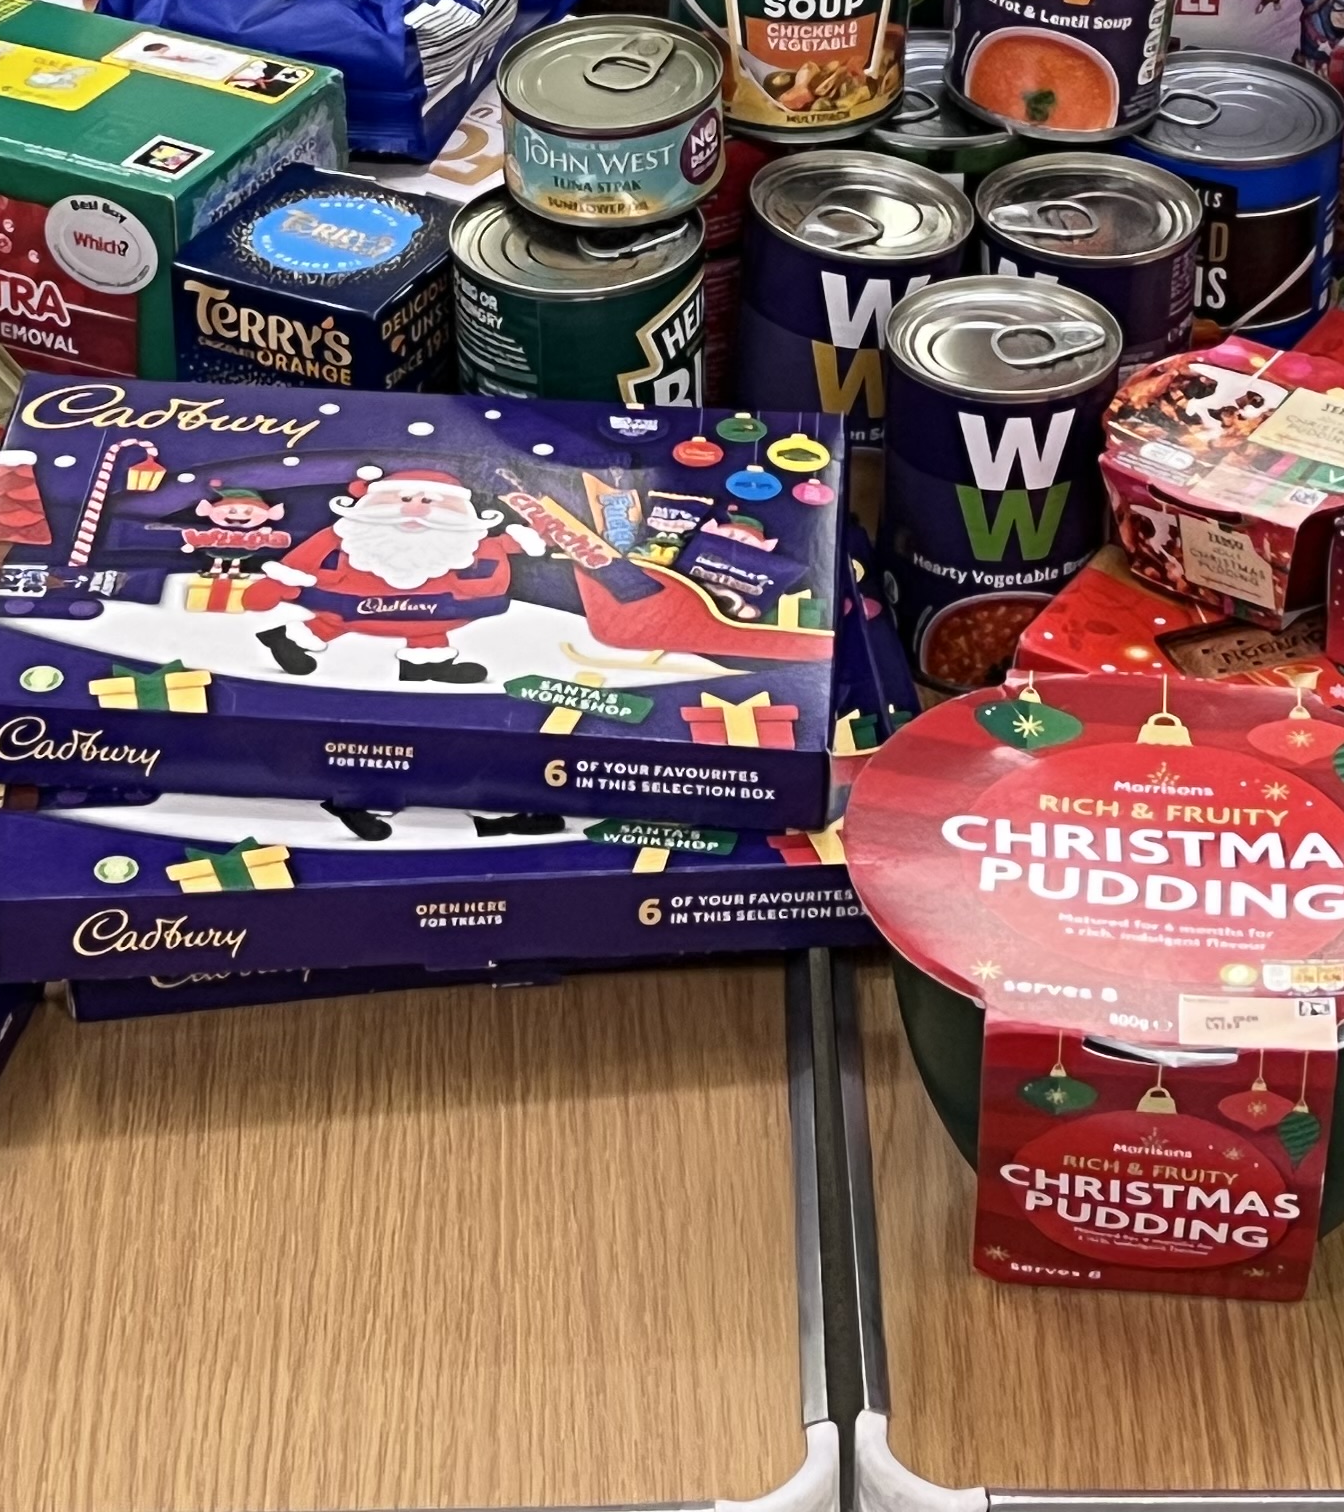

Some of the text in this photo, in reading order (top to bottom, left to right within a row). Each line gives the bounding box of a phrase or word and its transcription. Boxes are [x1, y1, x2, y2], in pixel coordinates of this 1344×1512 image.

[767, 22, 844, 39] CHICKEN
[1024, 5, 1036, 19] &
[1040, 9, 1090, 29] Lentil
[1093, 16, 1133, 30] Soup
[767, 34, 858, 52] VEGETABLE
[691, 117, 718, 154] NO
[523, 133, 676, 176] JOHN WEST
[73, 230, 130, 257] Which?
[256, 347, 353, 387] ORANGE
[21, 383, 321, 449] Cadbury
[958, 408, 1076, 491] W
[955, 480, 1072, 562] W
[913, 552, 1059, 589] Hearty Vegetable
[521, 687, 634, 718] WORKSHOP
[538, 679, 620, 705] SANTA'S
[325, 741, 415, 760] OPEN HERE
[327, 755, 411, 771] FOR TREATS
[543, 758, 761, 789] 6 OF YOUR FAVOURITES
[575, 776, 777, 802] IN THIS SELECTION BOX
[1113, 779, 1215, 797] Morrisons
[1038, 793, 1290, 829] RICH & FRUITY
[603, 833, 720, 852] WORKSHOP
[72, 909, 248, 959] Cadbury
[1062, 1154, 1240, 1186] RICH & FRUITY
[999, 1163, 1302, 1220] CHRISTMAS
[1025, 1189, 1270, 1249] PUDDING
